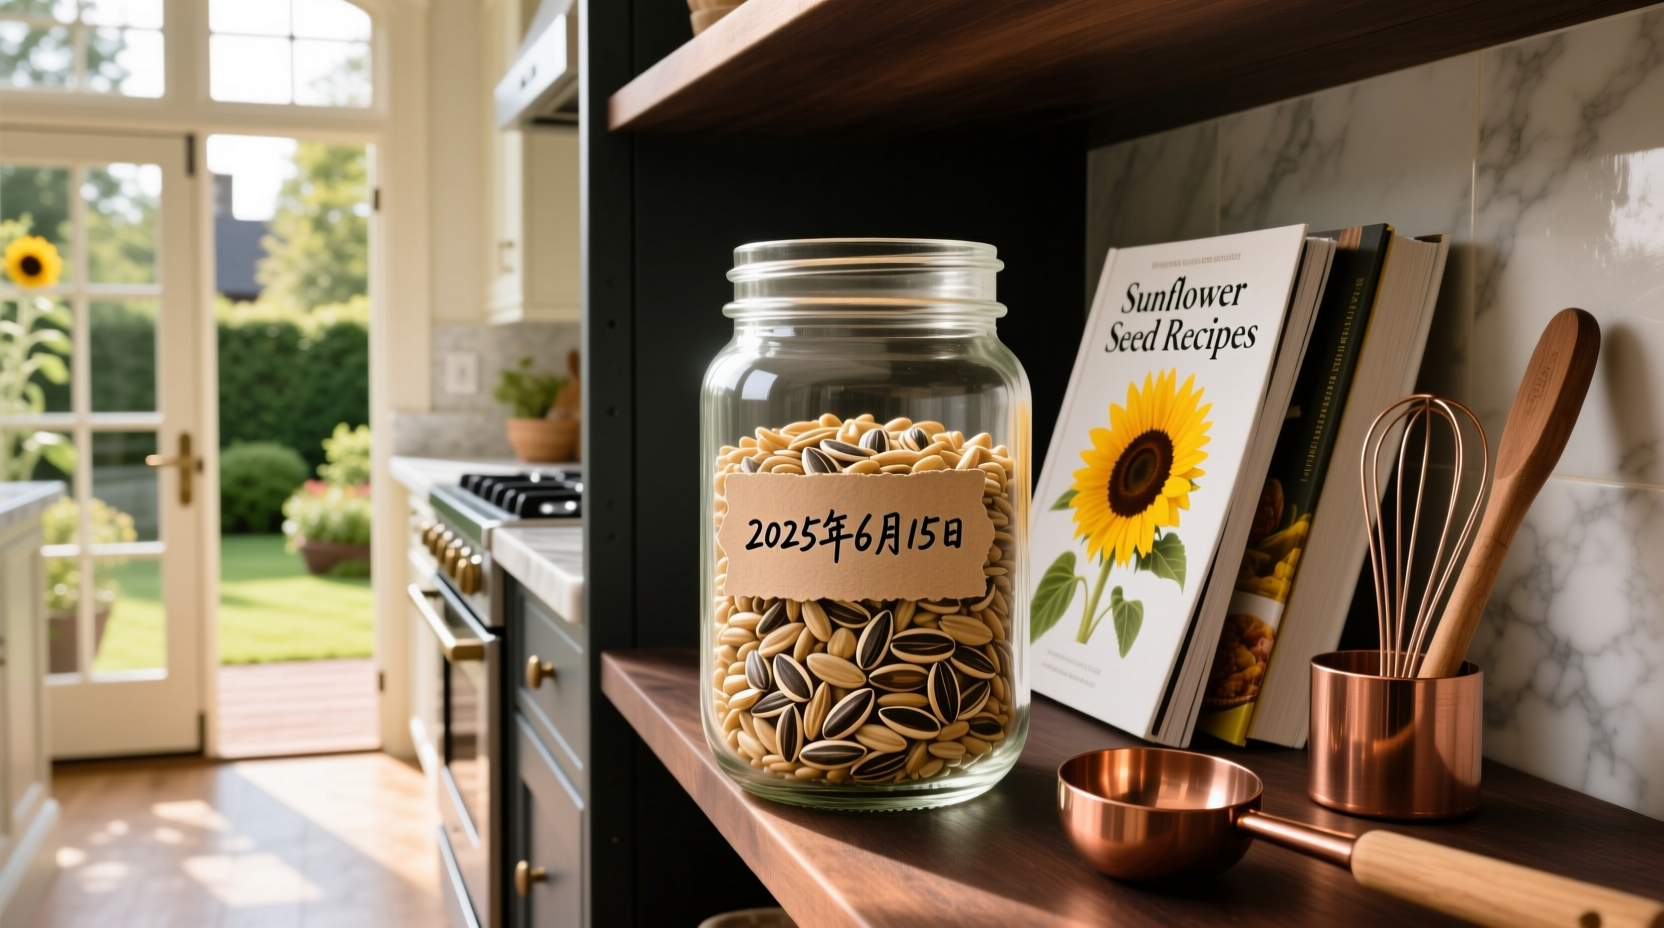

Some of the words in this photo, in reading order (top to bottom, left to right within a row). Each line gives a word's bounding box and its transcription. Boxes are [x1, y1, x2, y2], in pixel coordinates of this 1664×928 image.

[1121, 276, 1248, 314] Sunflower
[1105, 319, 1161, 353] Seed
[1162, 317, 1258, 360] Recipes
[745, 509, 963, 564] 2025年6月15日
